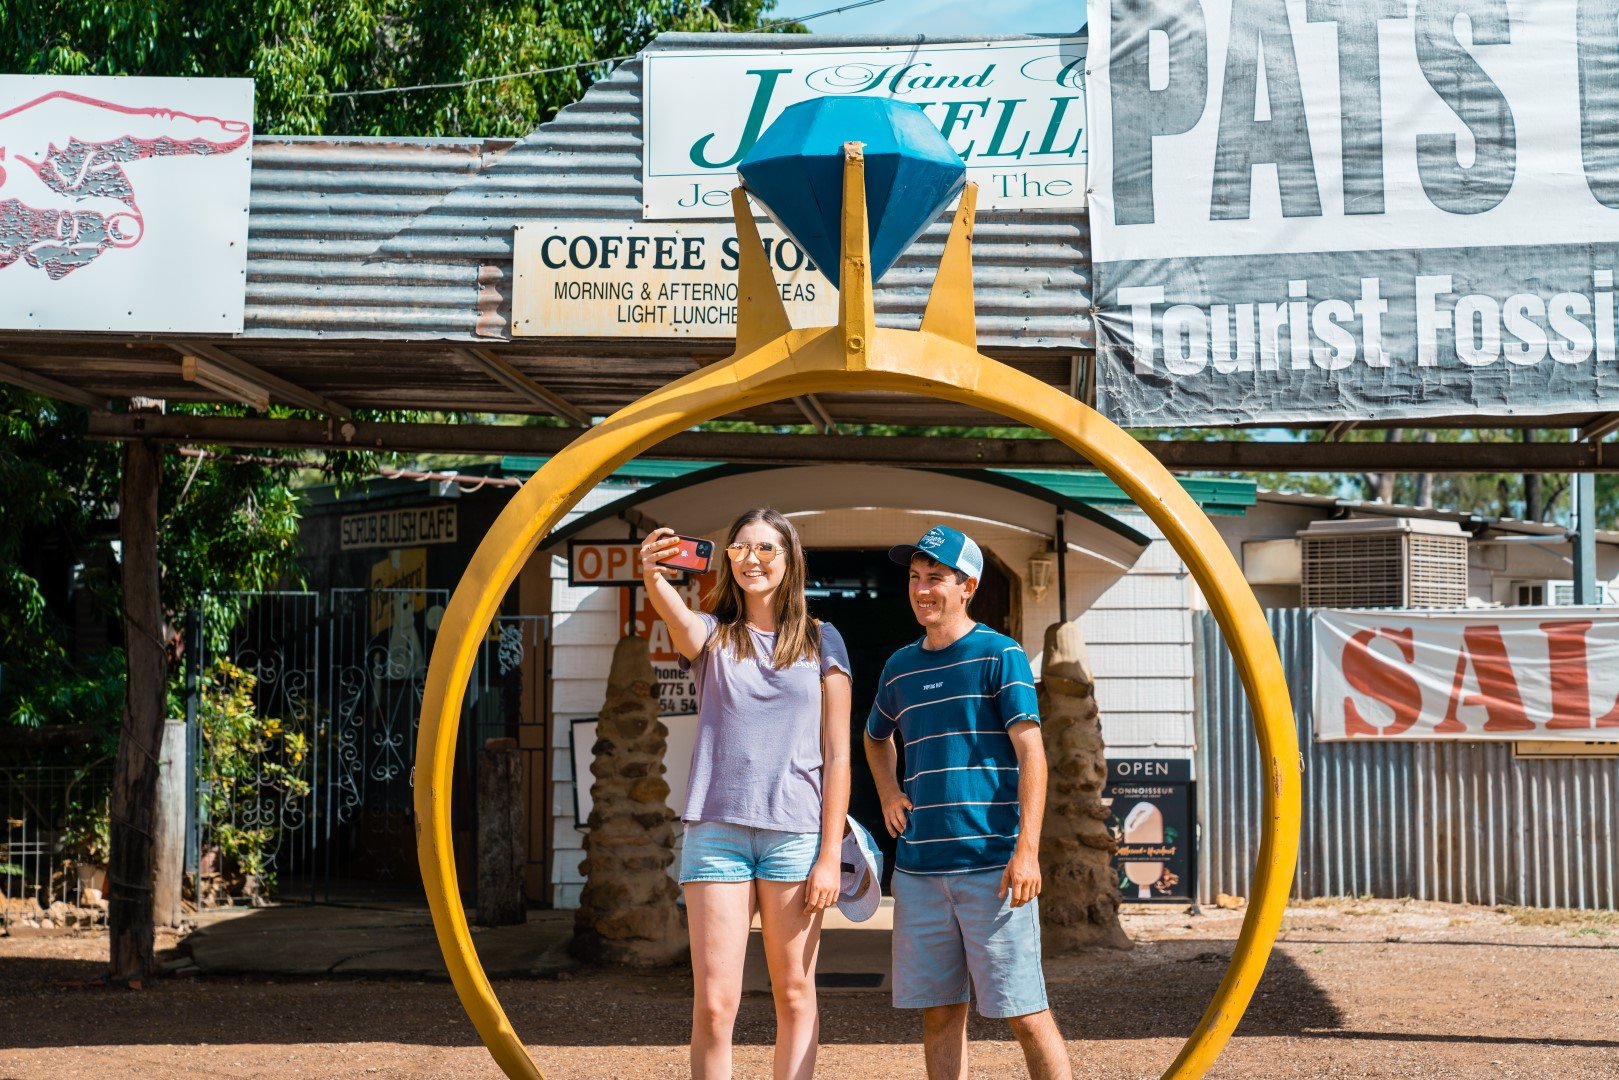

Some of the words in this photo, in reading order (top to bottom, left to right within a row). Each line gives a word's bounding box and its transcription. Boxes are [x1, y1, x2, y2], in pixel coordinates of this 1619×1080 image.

[806, 62, 996, 94] Hand
[1110, 0, 1517, 226] PATS
[992, 172, 1073, 199] The
[541, 235, 706, 270] COFFEE
[554, 281, 634, 300] MORNING
[641, 283, 651, 300] &
[777, 284, 815, 301] EAS
[617, 305, 667, 323] LIGHT
[1117, 277, 1391, 375] Tourist
[420, 507, 454, 540] CAFE
[1117, 762, 1168, 775] OPEN
[1111, 787, 1174, 795] CONNOISSEUR
